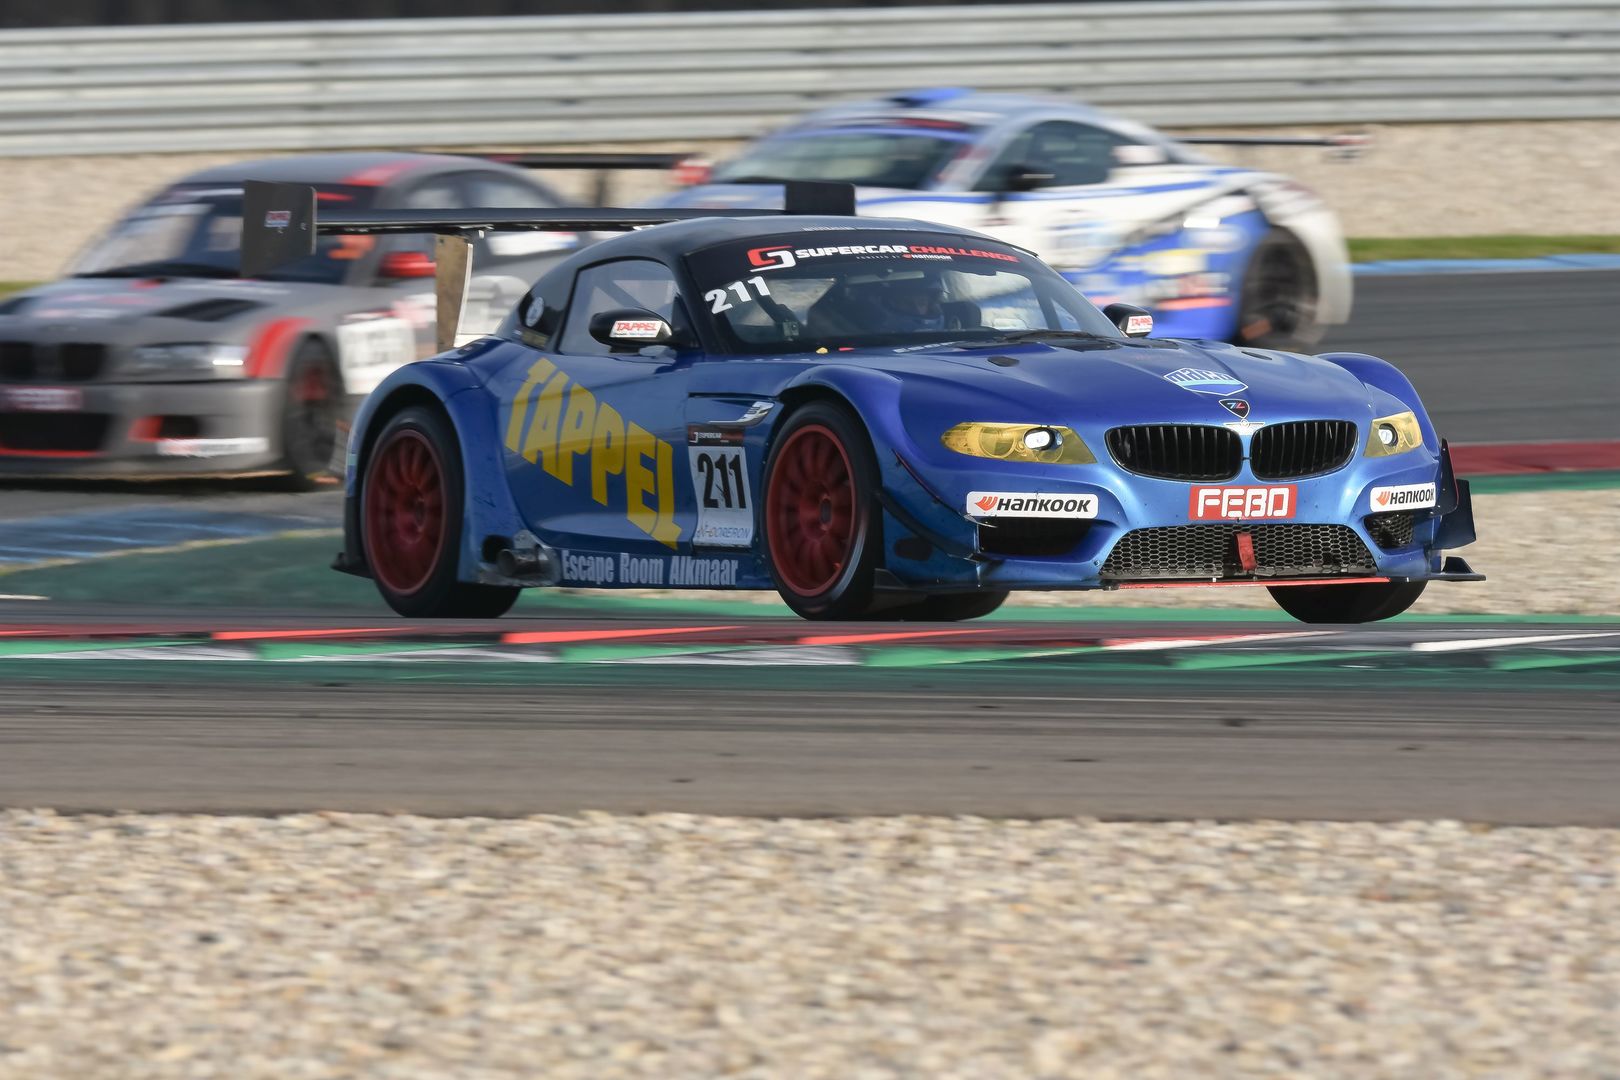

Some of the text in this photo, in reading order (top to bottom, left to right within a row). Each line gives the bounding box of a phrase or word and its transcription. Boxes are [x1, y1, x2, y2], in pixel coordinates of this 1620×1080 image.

[795, 245, 910, 259] SUPERCAR
[909, 245, 1021, 263] CHALLENGE
[704, 275, 771, 315] 211
[505, 357, 682, 550] TAPPEL
[697, 453, 747, 509] 211
[1197, 487, 1290, 518] FEBO
[561, 549, 739, 586] Escape Room Alkmaar
